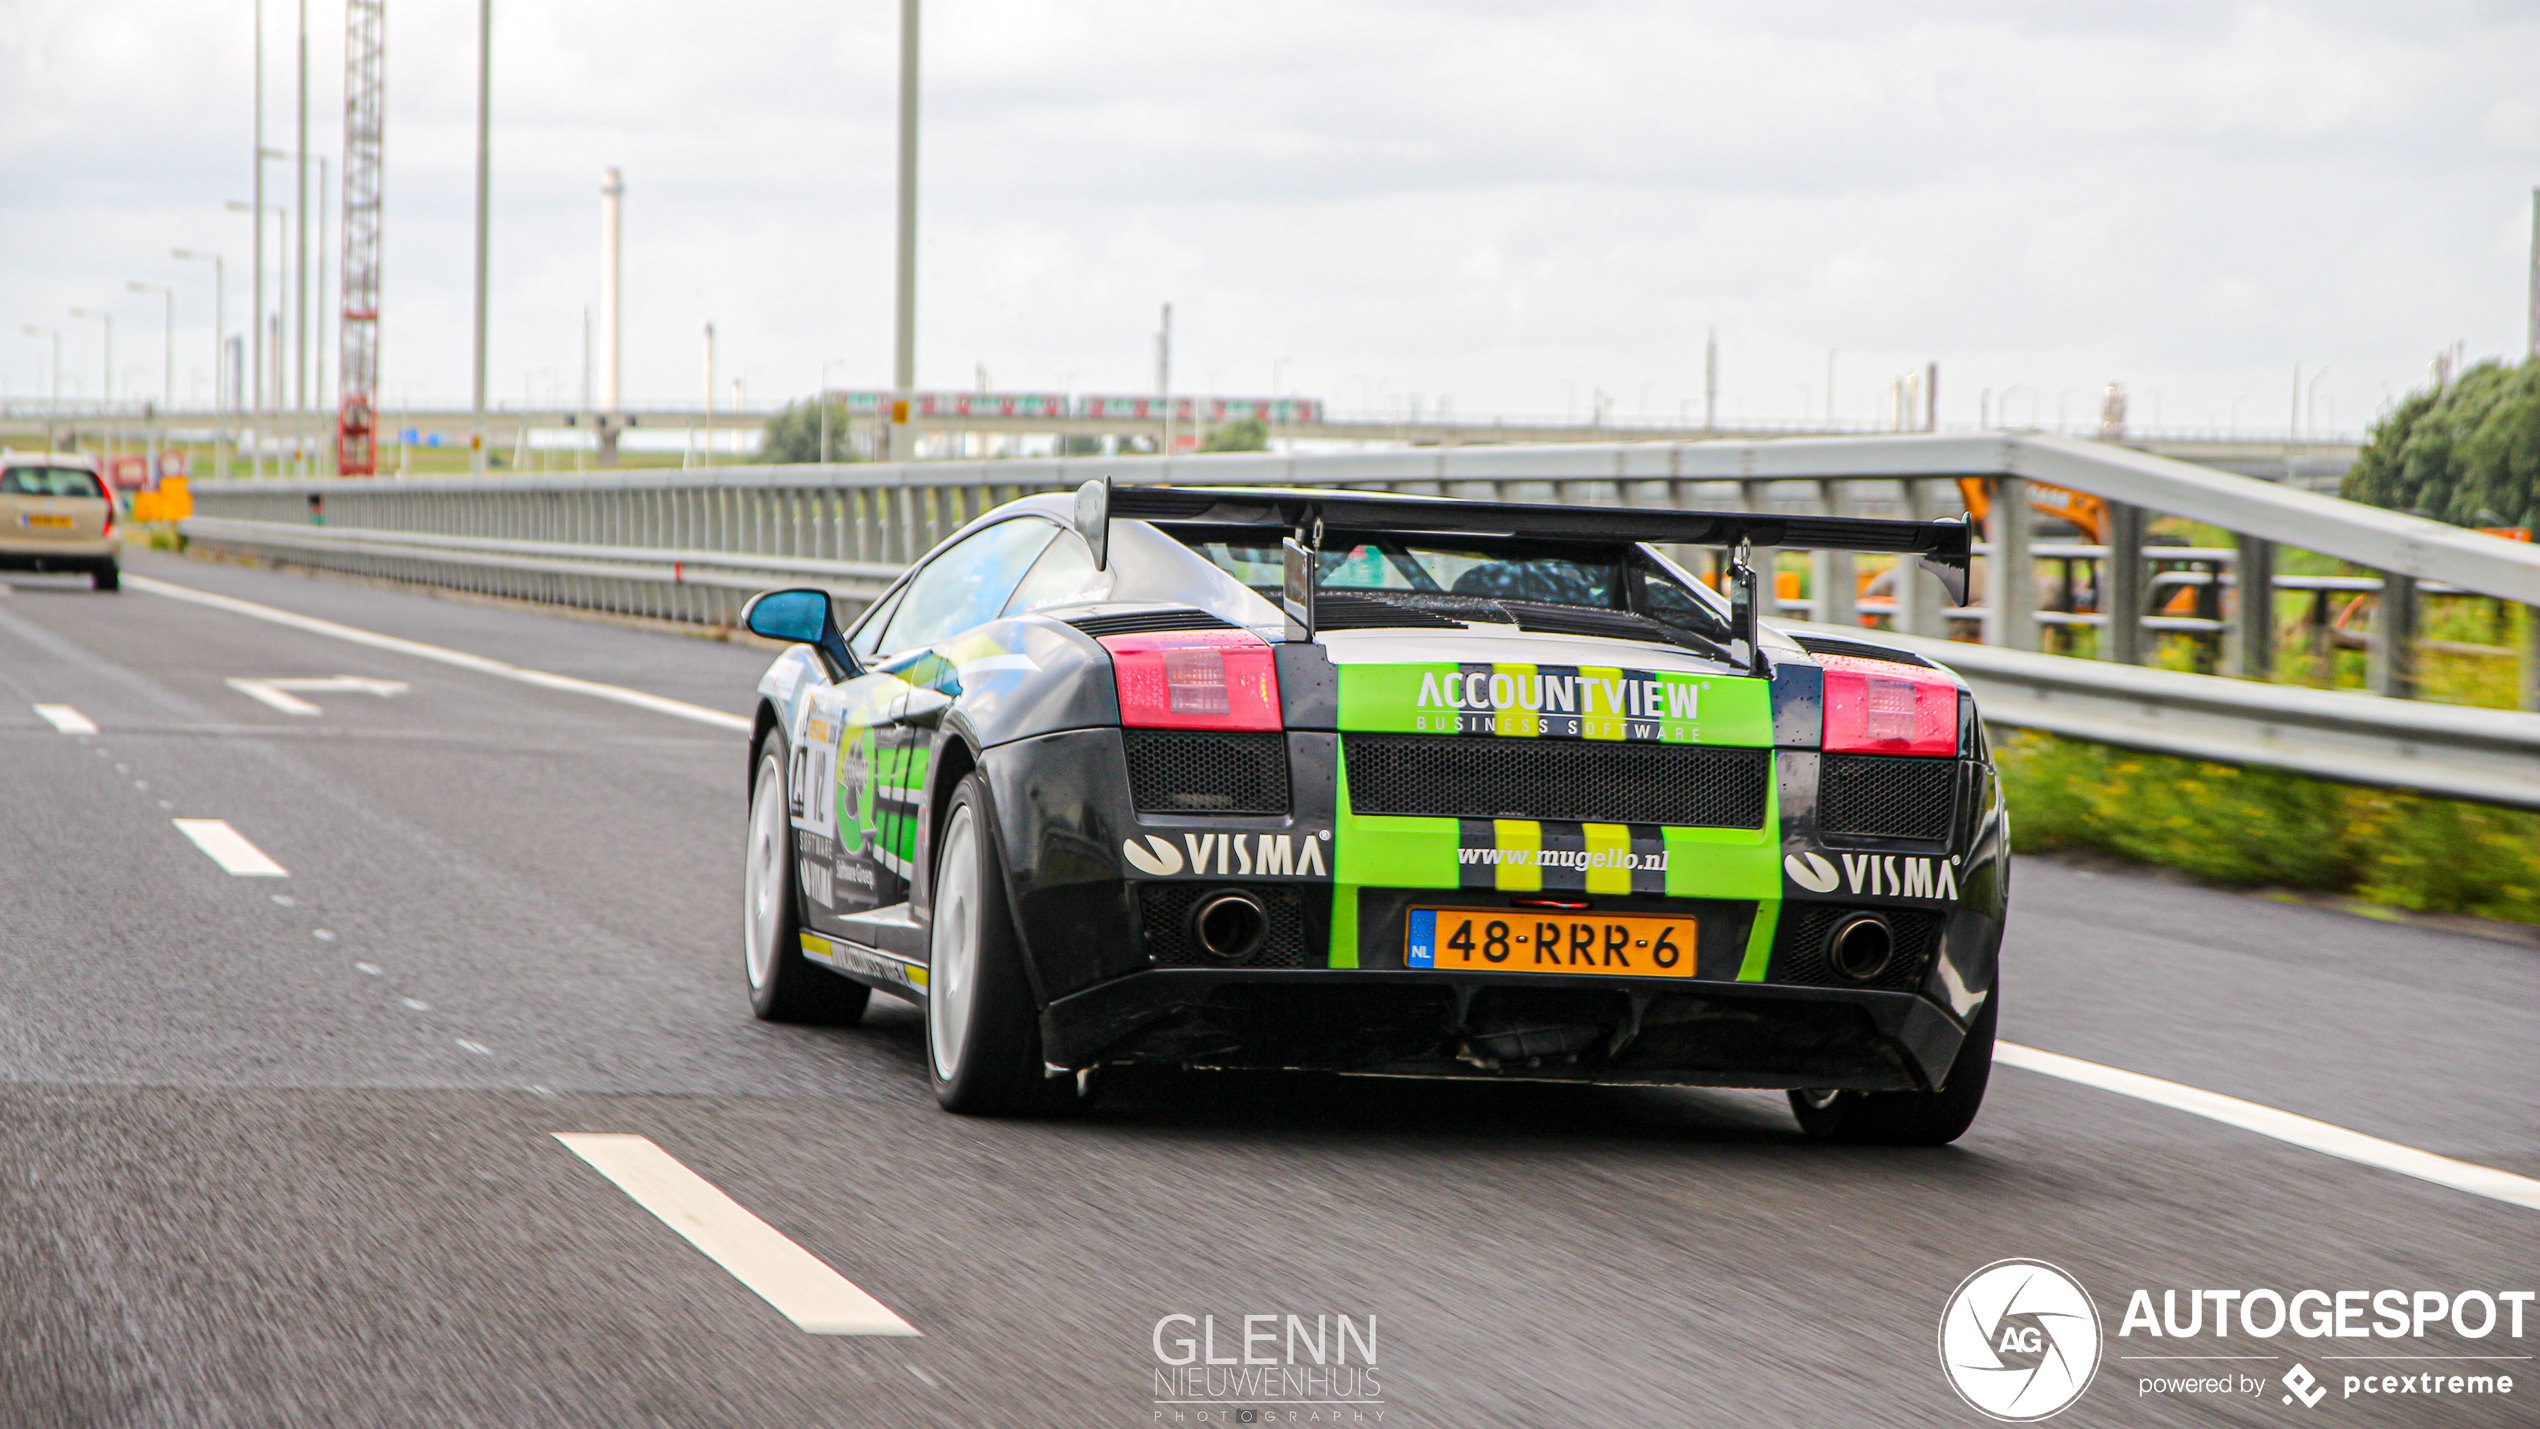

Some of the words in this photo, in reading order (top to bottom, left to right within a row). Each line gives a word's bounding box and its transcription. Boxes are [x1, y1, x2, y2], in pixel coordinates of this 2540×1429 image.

[1417, 716, 1548, 733] BUSINESS
[1568, 720, 1701, 742] SOFTWARE
[1457, 848, 1669, 872] www.mugello.nl
[1412, 945, 1431, 959] NL
[1447, 919, 1680, 968] 48-RRR-6
